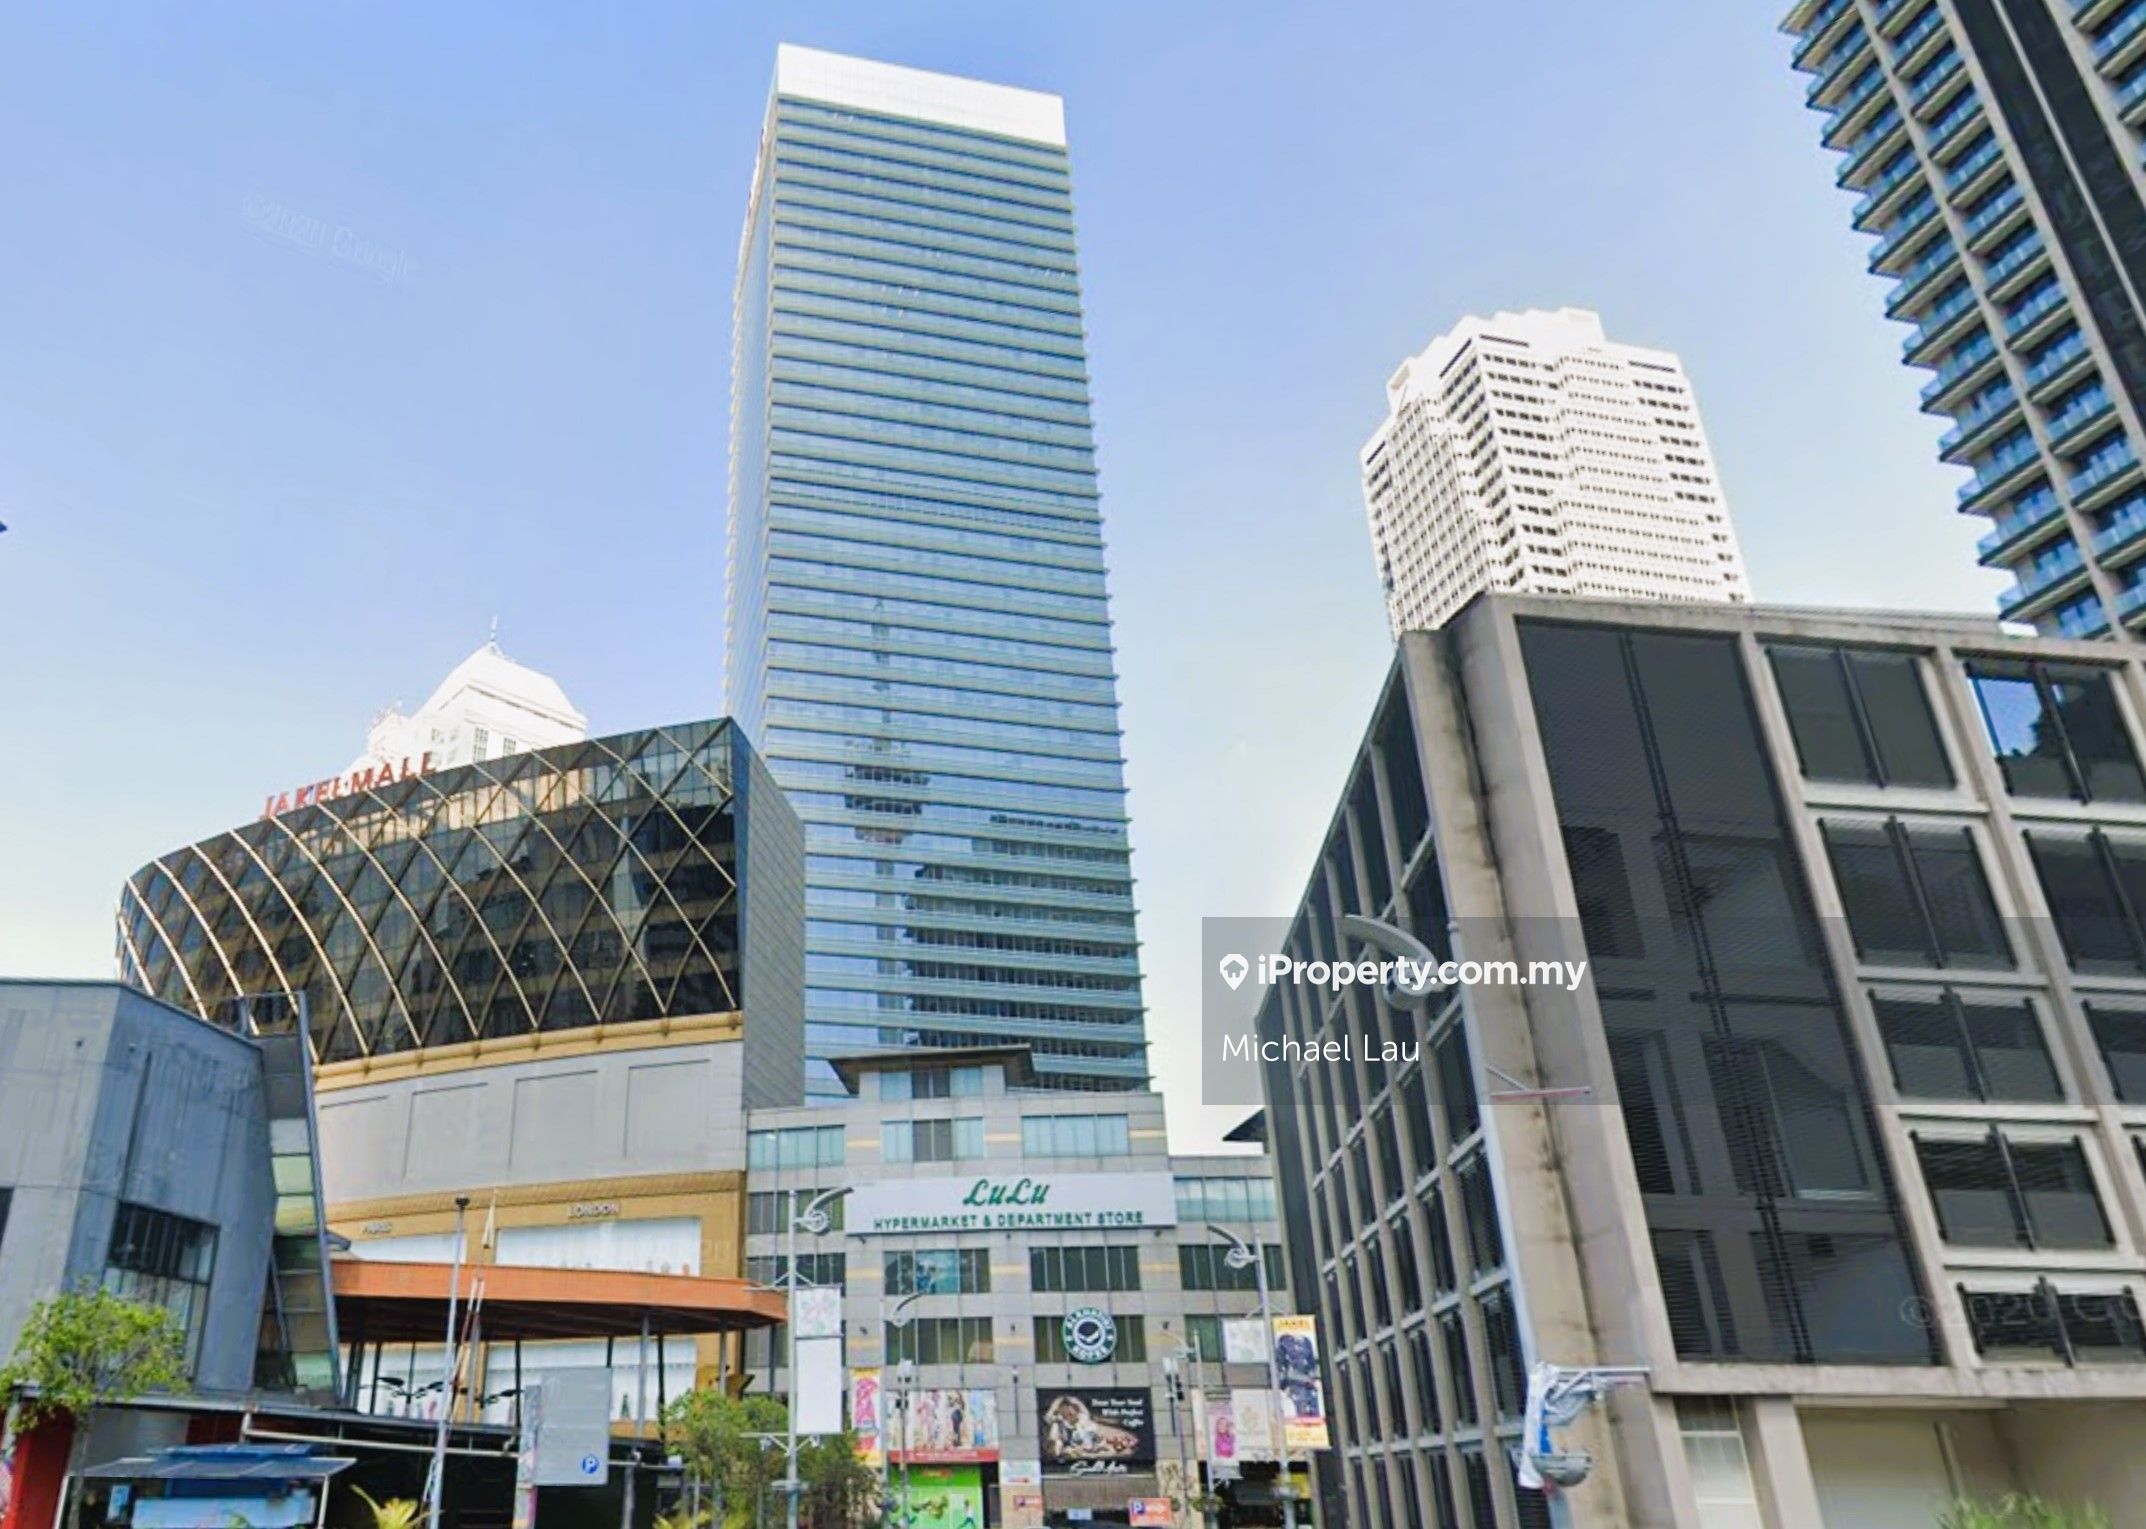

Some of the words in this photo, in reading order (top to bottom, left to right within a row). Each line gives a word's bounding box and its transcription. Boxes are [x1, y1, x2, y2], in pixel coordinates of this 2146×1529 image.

[351, 751, 436, 794] MALL
[963, 1178, 1050, 1206] LuLu
[568, 1203, 620, 1219] LONDON
[874, 1214, 977, 1230] HYPERMARKET
[983, 1213, 991, 1227] &
[999, 1212, 1093, 1227] DEPARTMENT
[1097, 1210, 1143, 1225] STORE
